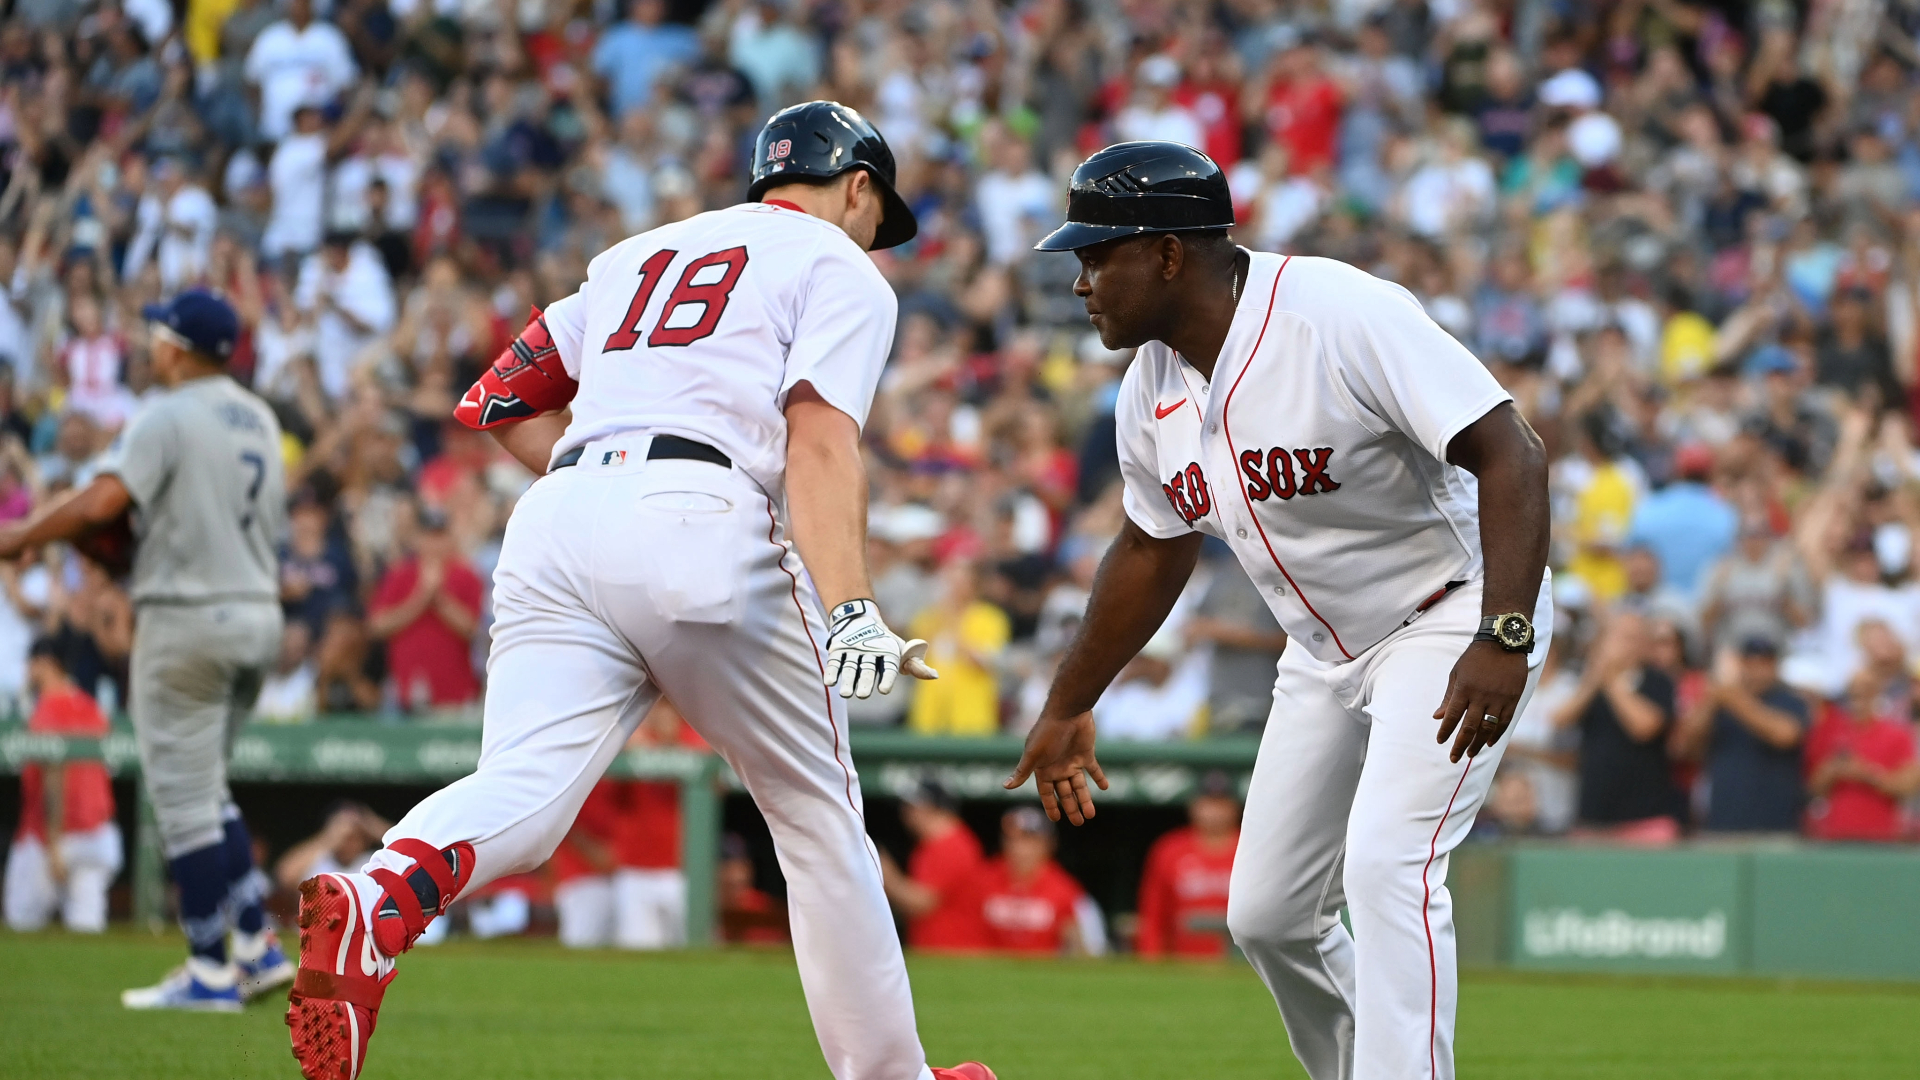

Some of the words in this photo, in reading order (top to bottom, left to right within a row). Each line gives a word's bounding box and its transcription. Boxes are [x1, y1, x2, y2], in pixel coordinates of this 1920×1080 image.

[766, 138, 792, 161] 18
[601, 245, 749, 354] 18
[1240, 446, 1342, 502] SOX
